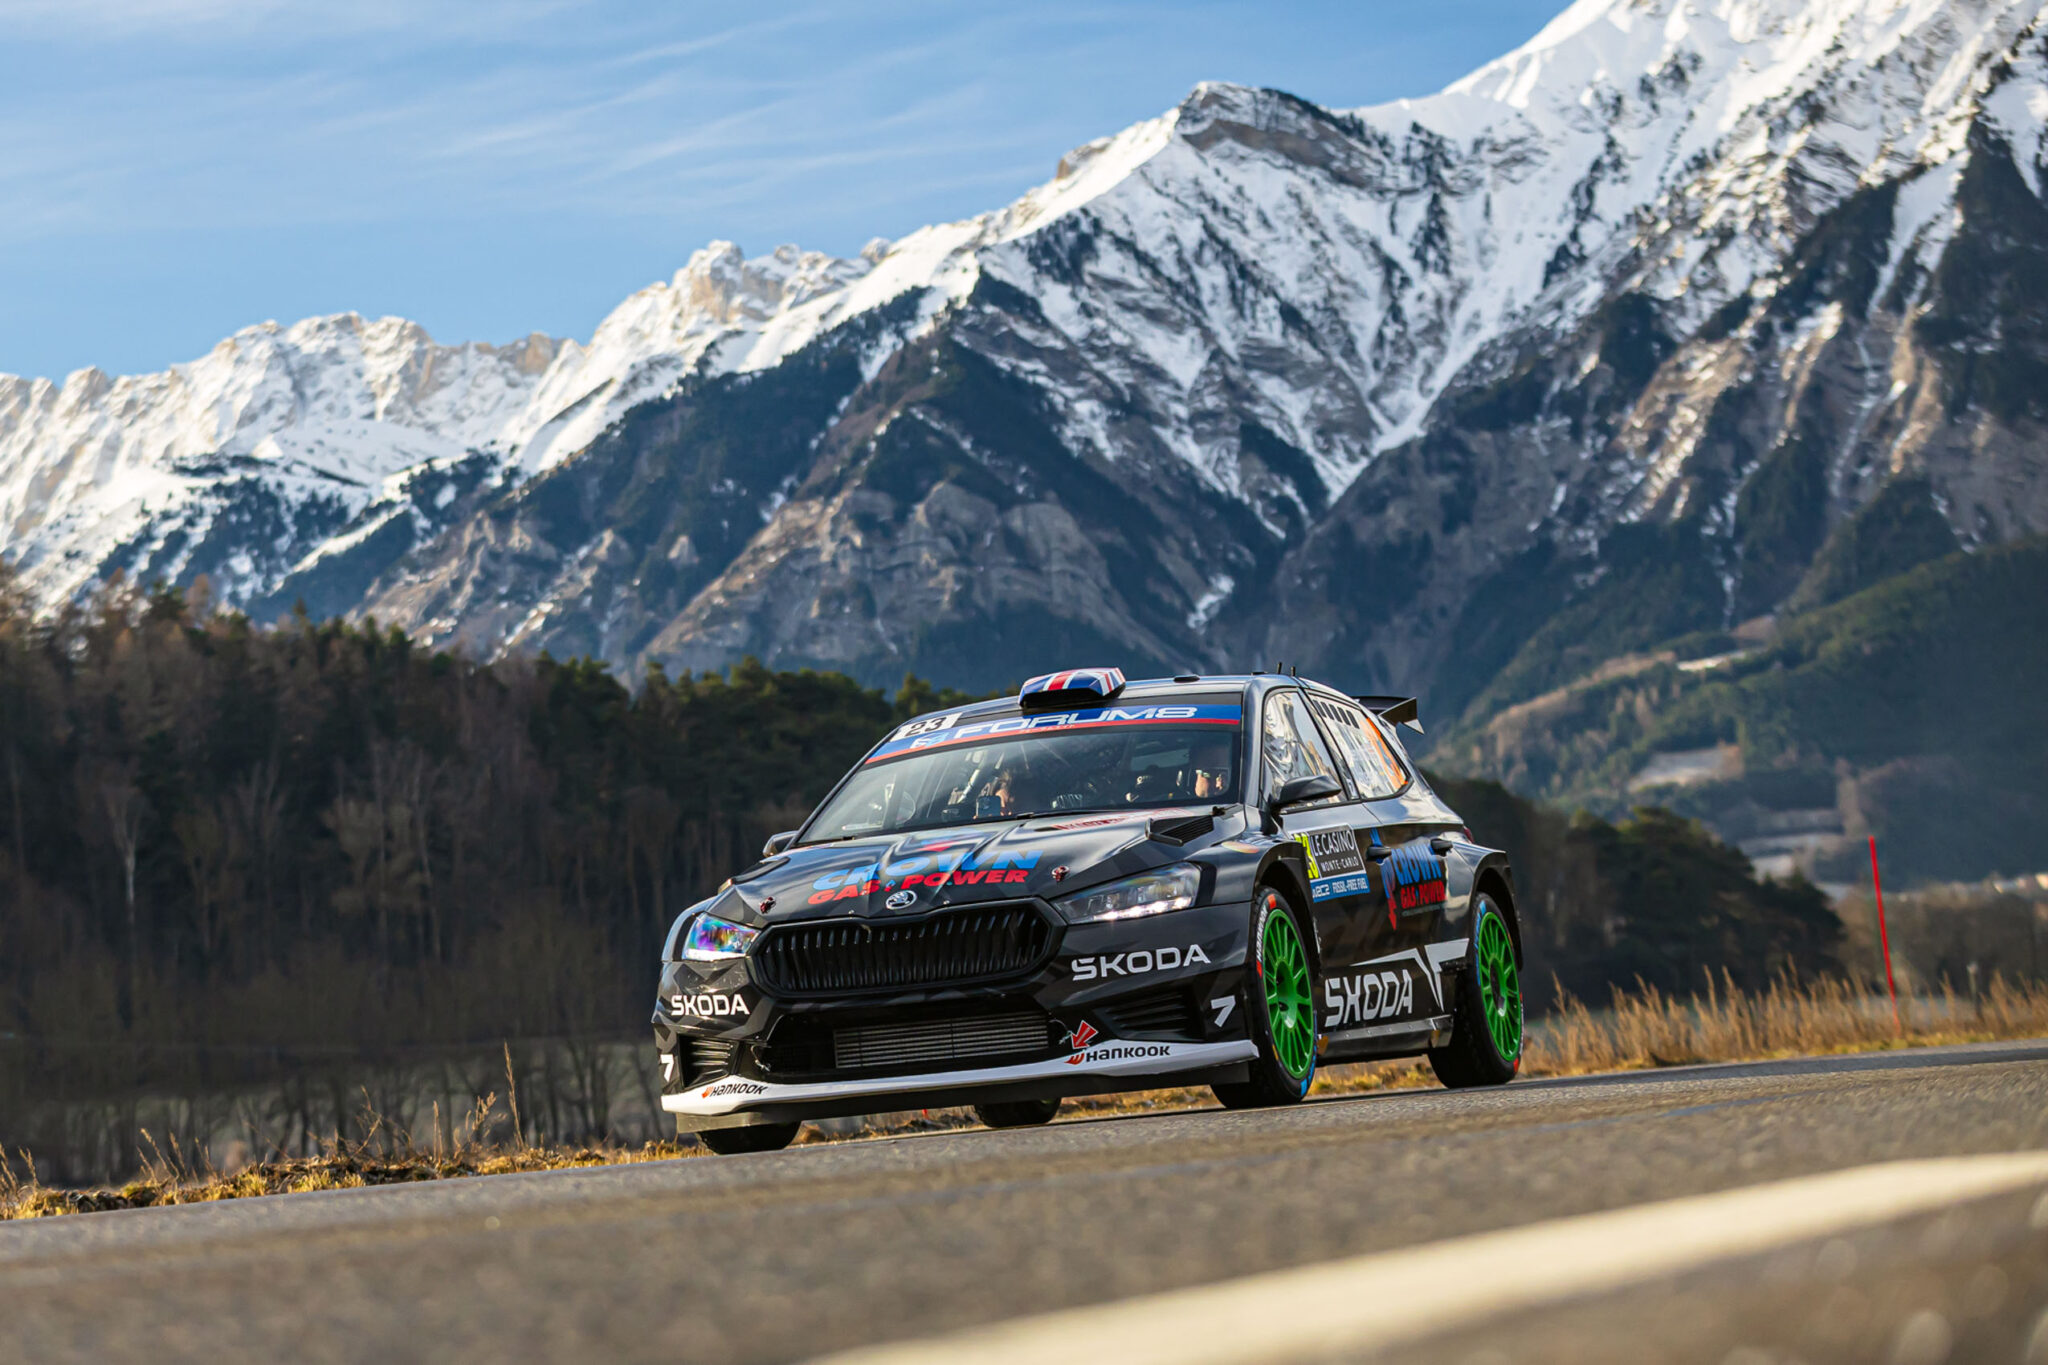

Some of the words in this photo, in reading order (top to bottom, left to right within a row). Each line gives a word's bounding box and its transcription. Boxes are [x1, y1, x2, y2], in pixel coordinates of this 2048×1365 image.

[905, 716, 945, 737] 23
[953, 705, 1198, 740] FORUM8
[1311, 834, 1323, 857] LE
[1322, 829, 1355, 856] CASINO
[813, 849, 1045, 891] CROWN
[1320, 856, 1360, 872] MONTE-CARLO
[1391, 843, 1443, 886] CROWN
[807, 879, 881, 905] GAS
[900, 869, 1030, 891] POWER
[1400, 885, 1417, 909] GAS
[1071, 943, 1212, 982] SKODA
[670, 993, 751, 1016] SKODA
[1210, 995, 1237, 1028] 7
[1324, 968, 1414, 1028] SKODA
[660, 1053, 675, 1083] 7
